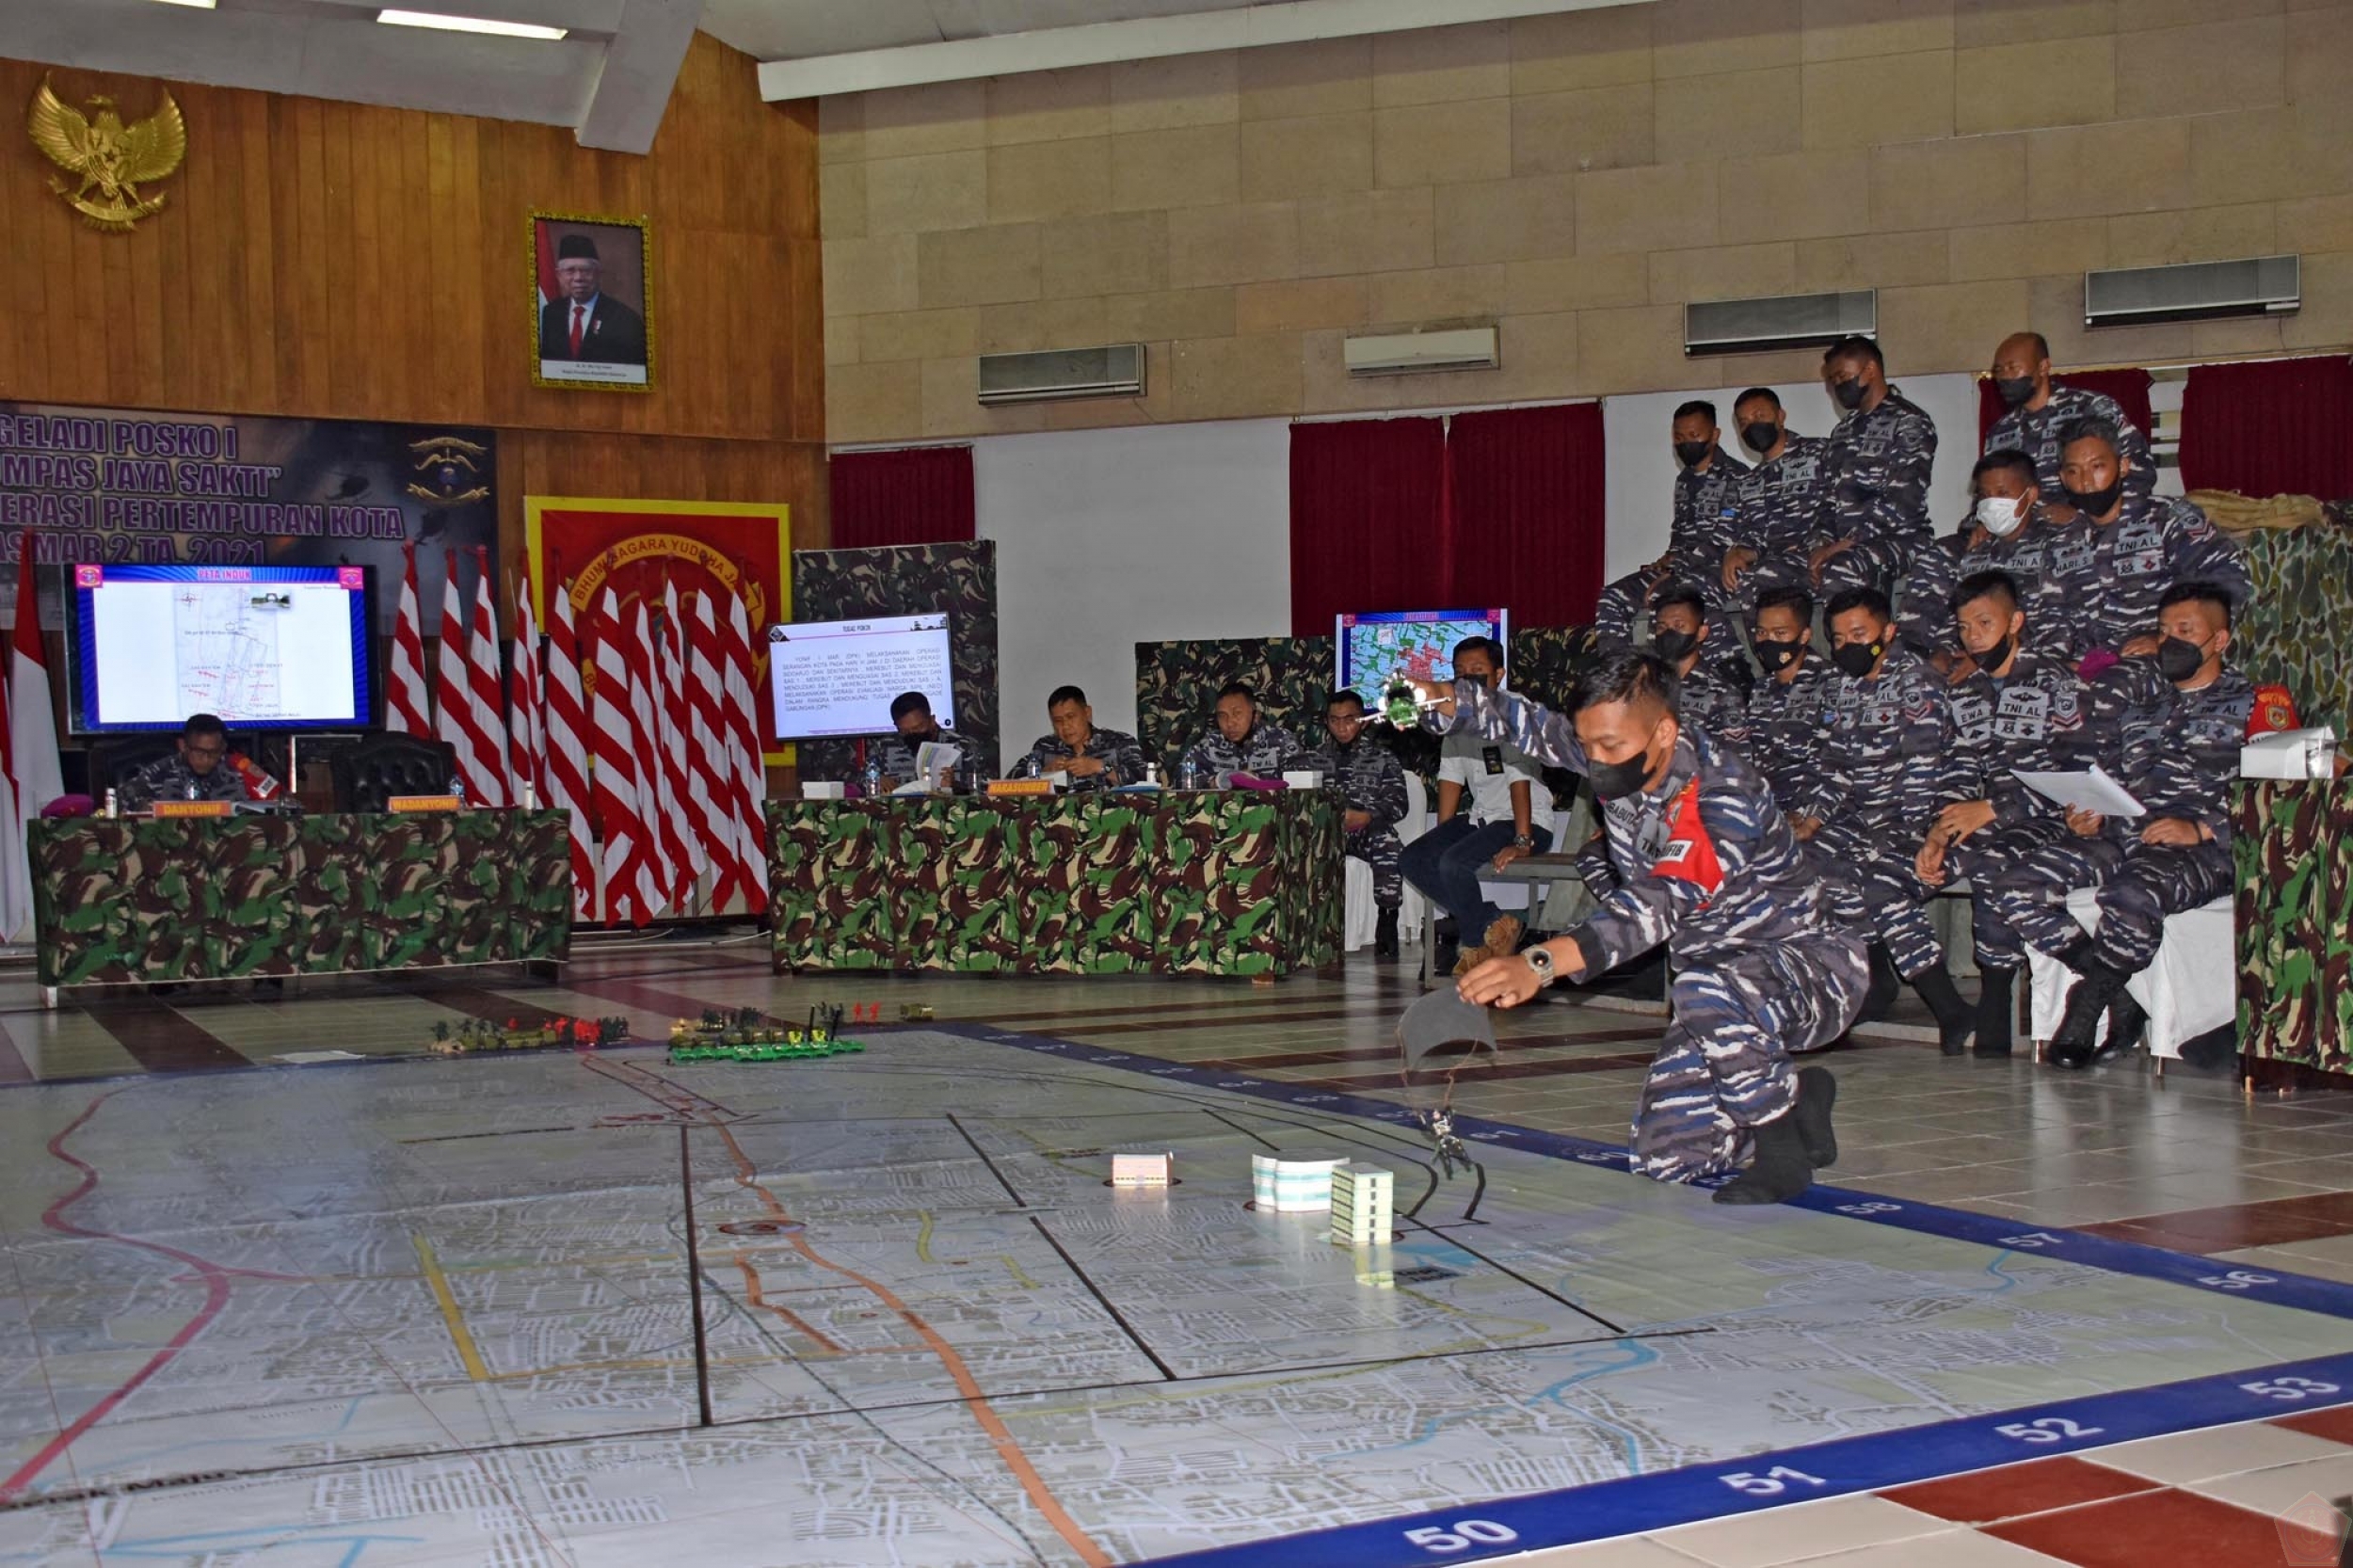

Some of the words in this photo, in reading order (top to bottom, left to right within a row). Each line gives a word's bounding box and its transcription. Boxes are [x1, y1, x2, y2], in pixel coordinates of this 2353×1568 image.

[112, 421, 218, 458] POSKO
[225, 427, 236, 458] I
[2, 453, 96, 490] MPAS
[102, 458, 173, 493] JAYA
[102, 496, 324, 536] PERTEMPURAN
[329, 505, 405, 539] KOTA
[109, 534, 131, 564] 2
[187, 536, 264, 565] 2021
[671, 538, 726, 575] YUDHA
[2119, 540, 2138, 552] TNI
[2140, 536, 2158, 548] AL
[2003, 702, 2023, 713] TNI
[2026, 705, 2041, 716] AL
[2221, 705, 2238, 716] AL
[1470, 1129, 1522, 1140] 61
[1833, 1201, 1903, 1215] 58
[1997, 1231, 2067, 1249] 57
[2198, 1269, 2279, 1290] 56
[2239, 1376, 2342, 1400] 53
[1993, 1416, 2105, 1443] 52
[1719, 1464, 1827, 1496] 51
[1403, 1519, 1518, 1554] 50
